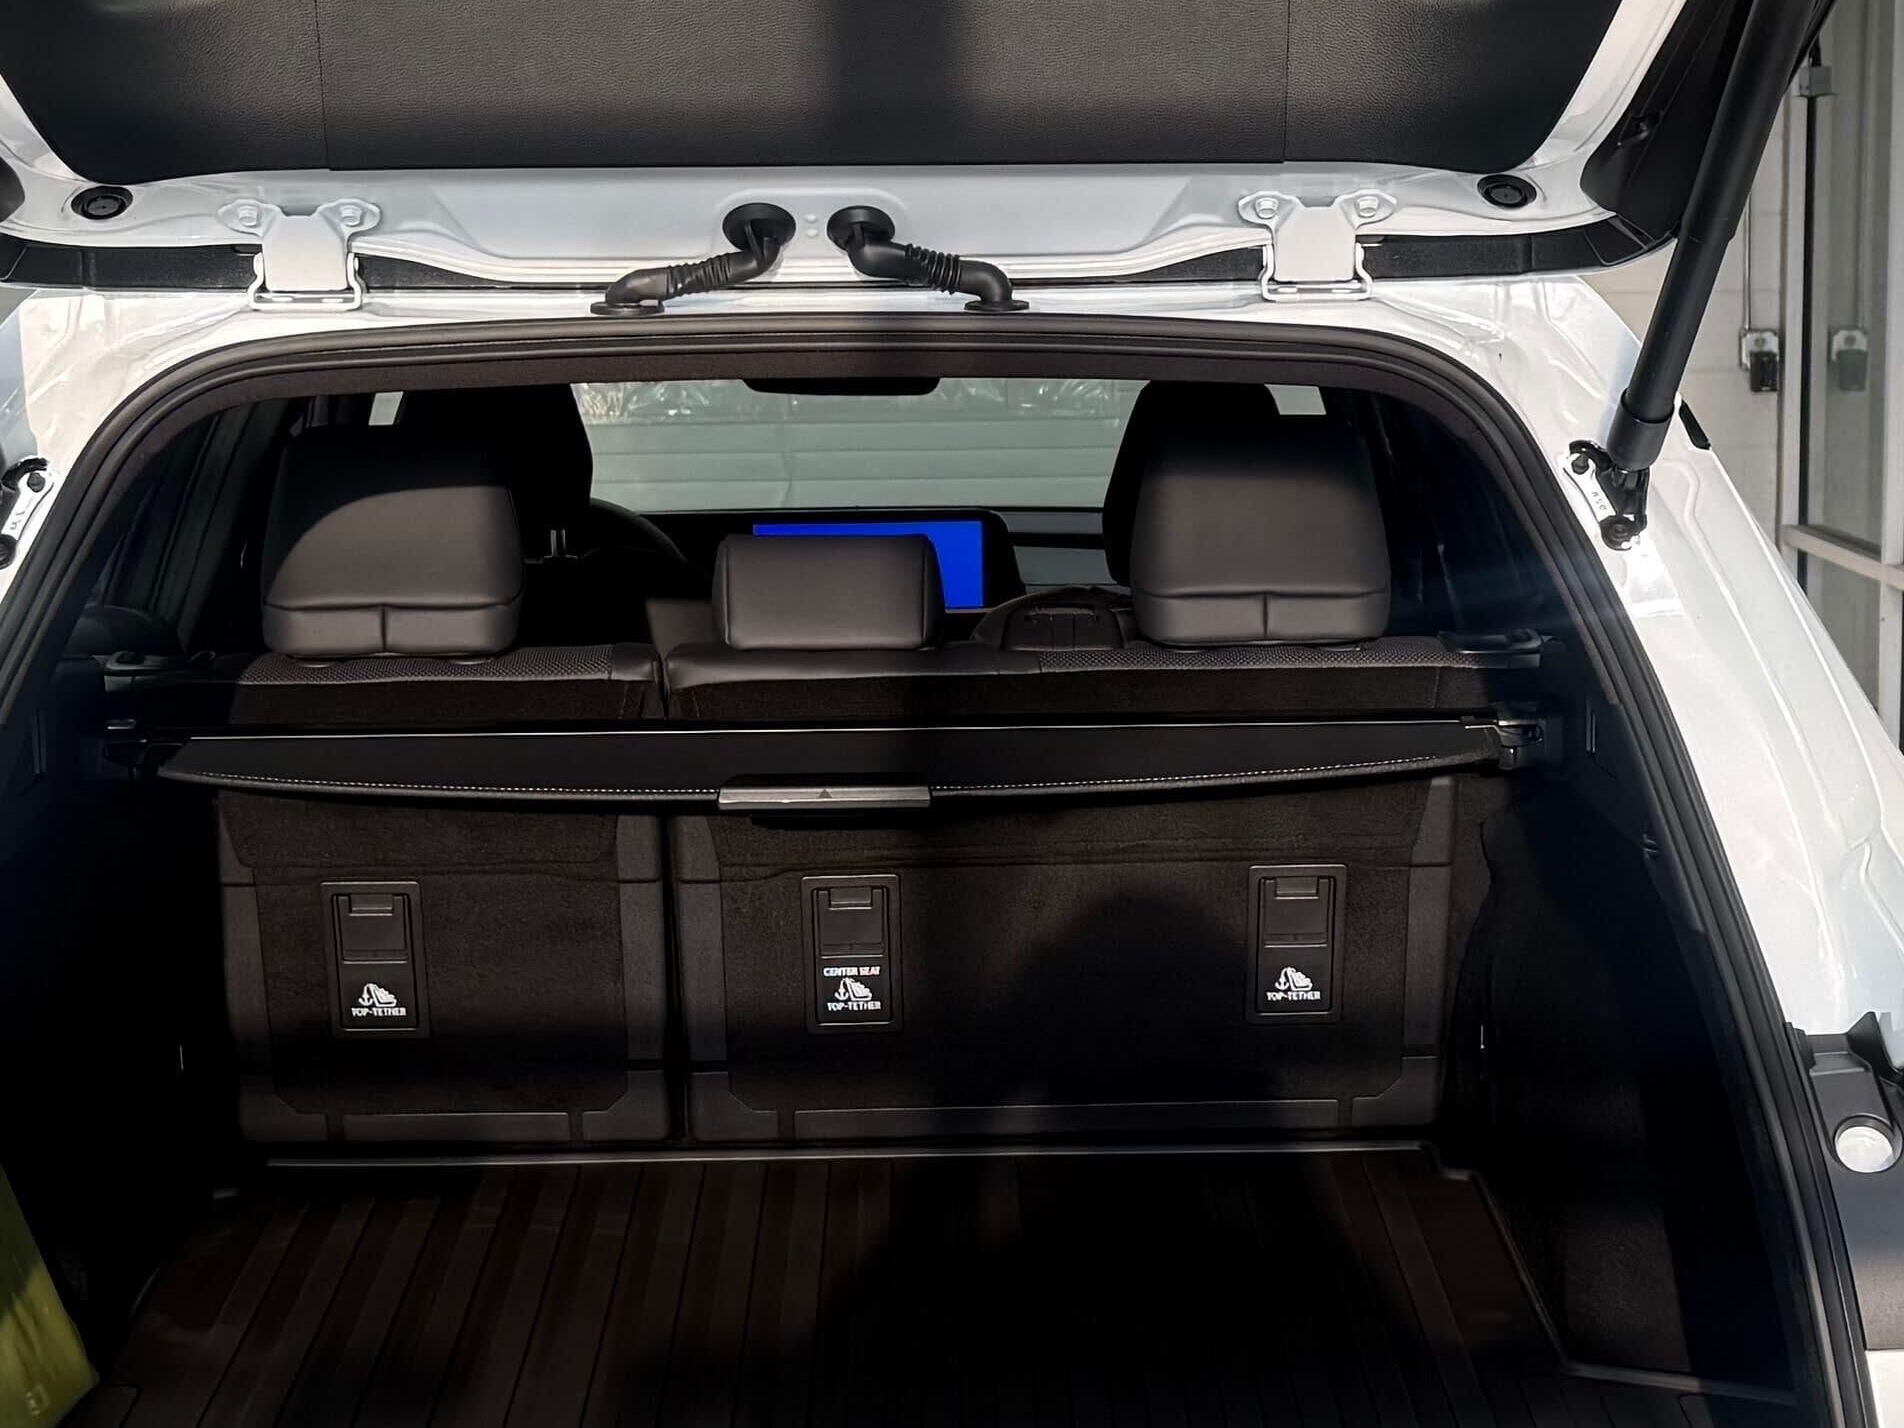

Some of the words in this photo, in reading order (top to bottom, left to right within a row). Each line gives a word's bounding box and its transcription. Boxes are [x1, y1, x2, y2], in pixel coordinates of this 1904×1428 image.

[823, 967, 858, 977] CENTER
[859, 966, 881, 976] SEAT
[1266, 991, 1321, 1001] TOP-TETHER
[826, 1001, 882, 1012] TOP-TETHER
[351, 1007, 406, 1017] TOP-TETHER
